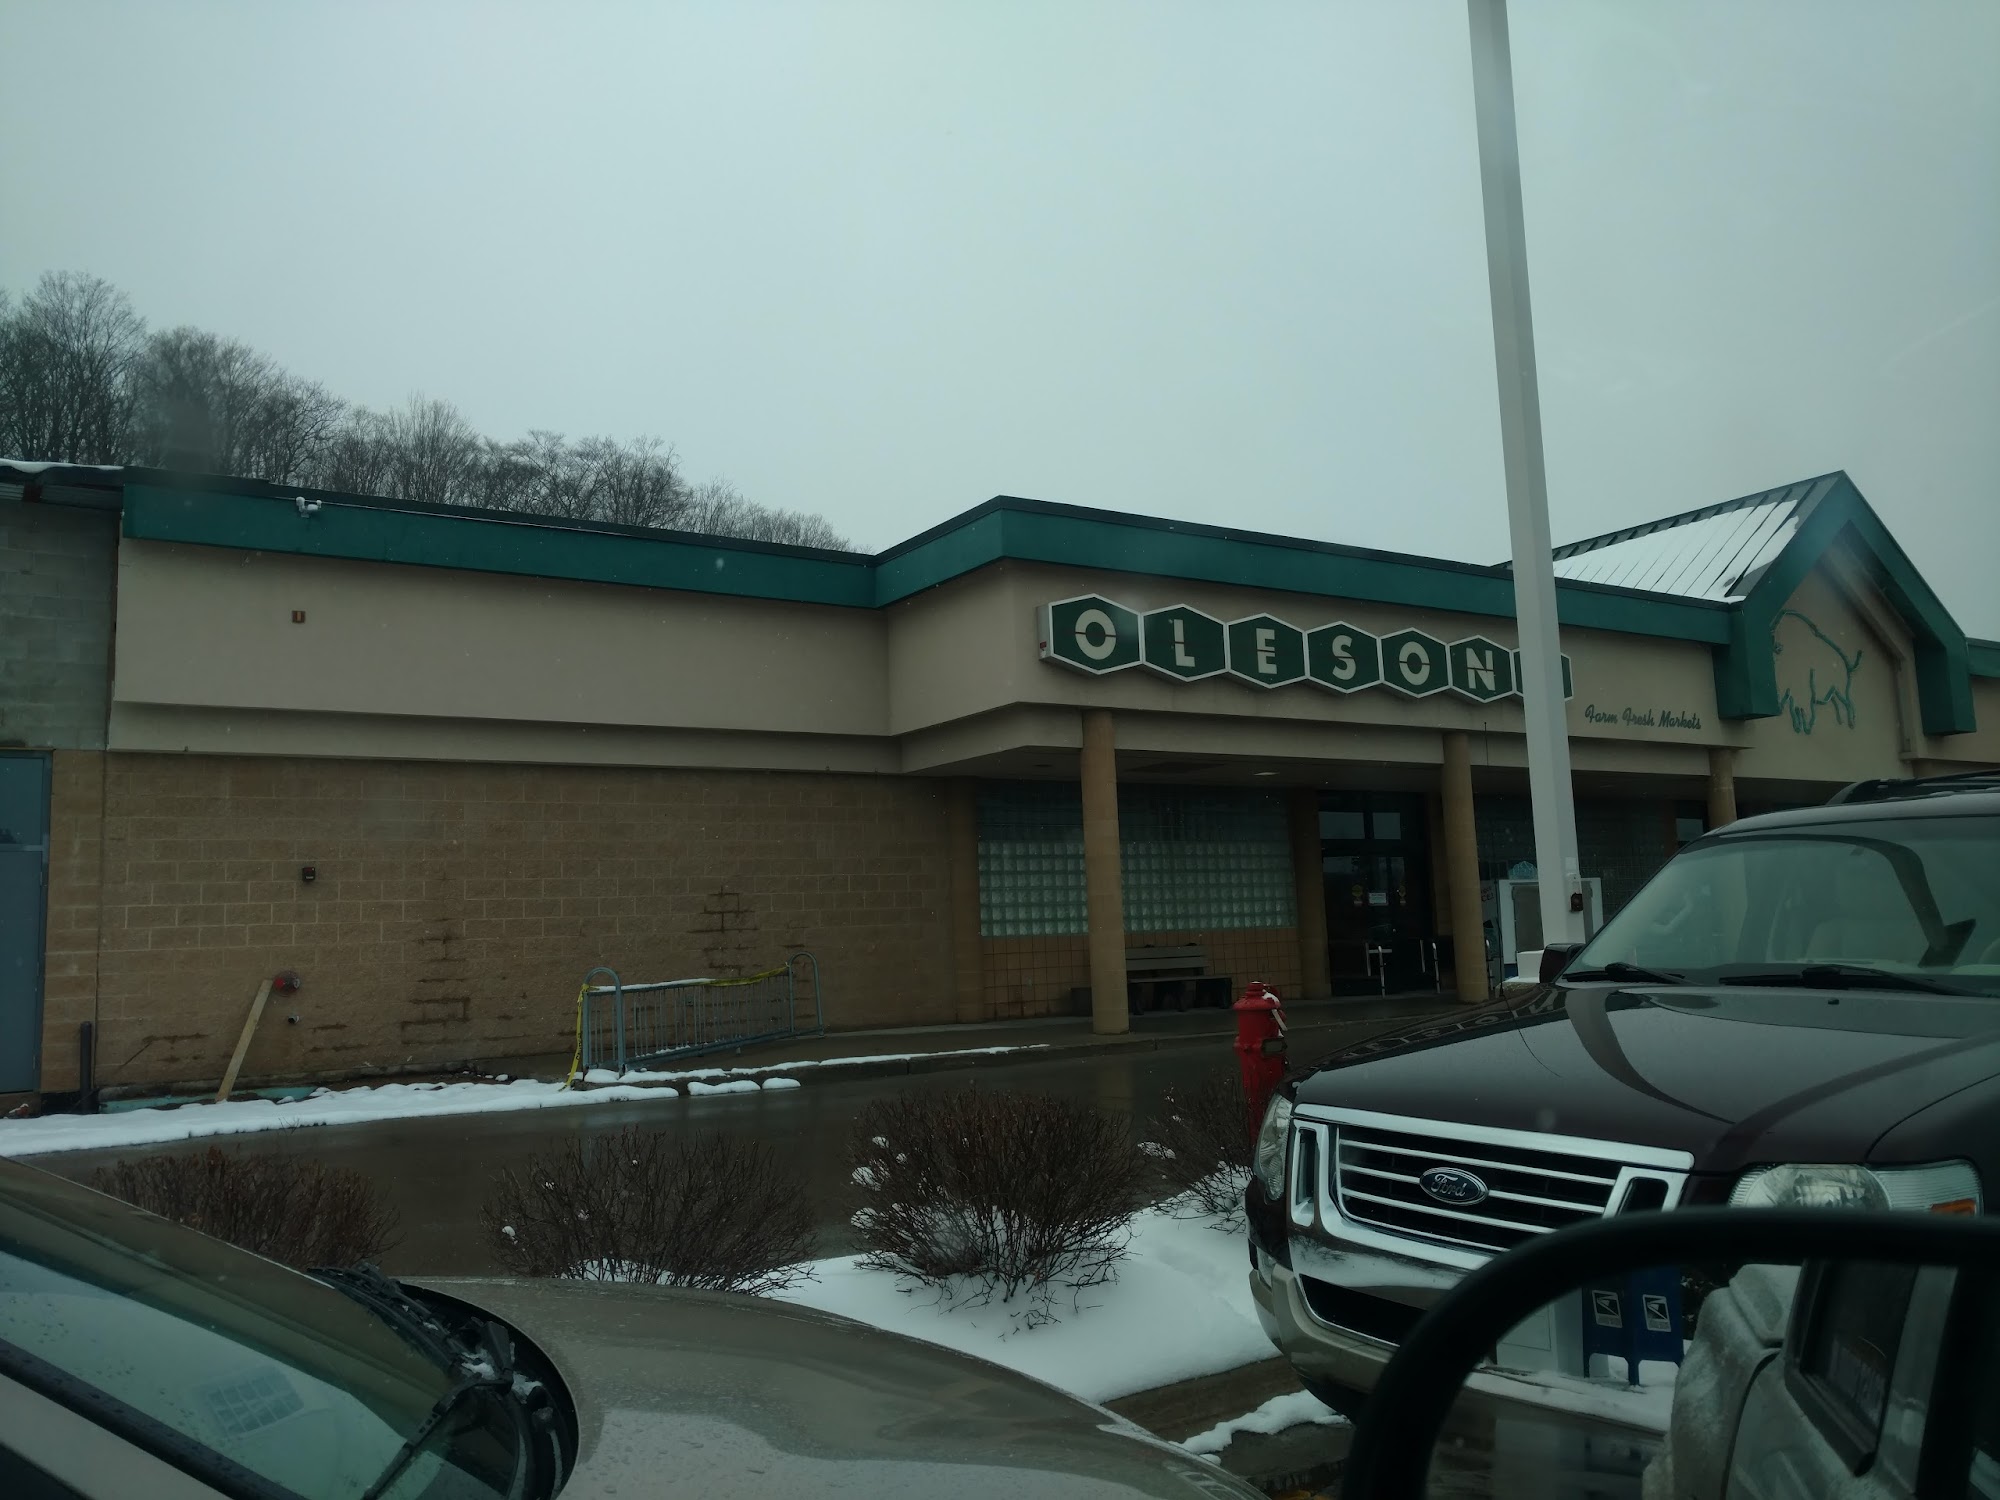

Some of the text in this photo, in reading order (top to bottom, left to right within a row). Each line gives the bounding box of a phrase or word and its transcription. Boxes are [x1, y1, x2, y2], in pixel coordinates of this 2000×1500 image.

[1074, 608, 1498, 692] OLESON
[1584, 704, 1702, 730] Farm Fresh Markets
[1431, 1173, 1468, 1197] Ford
